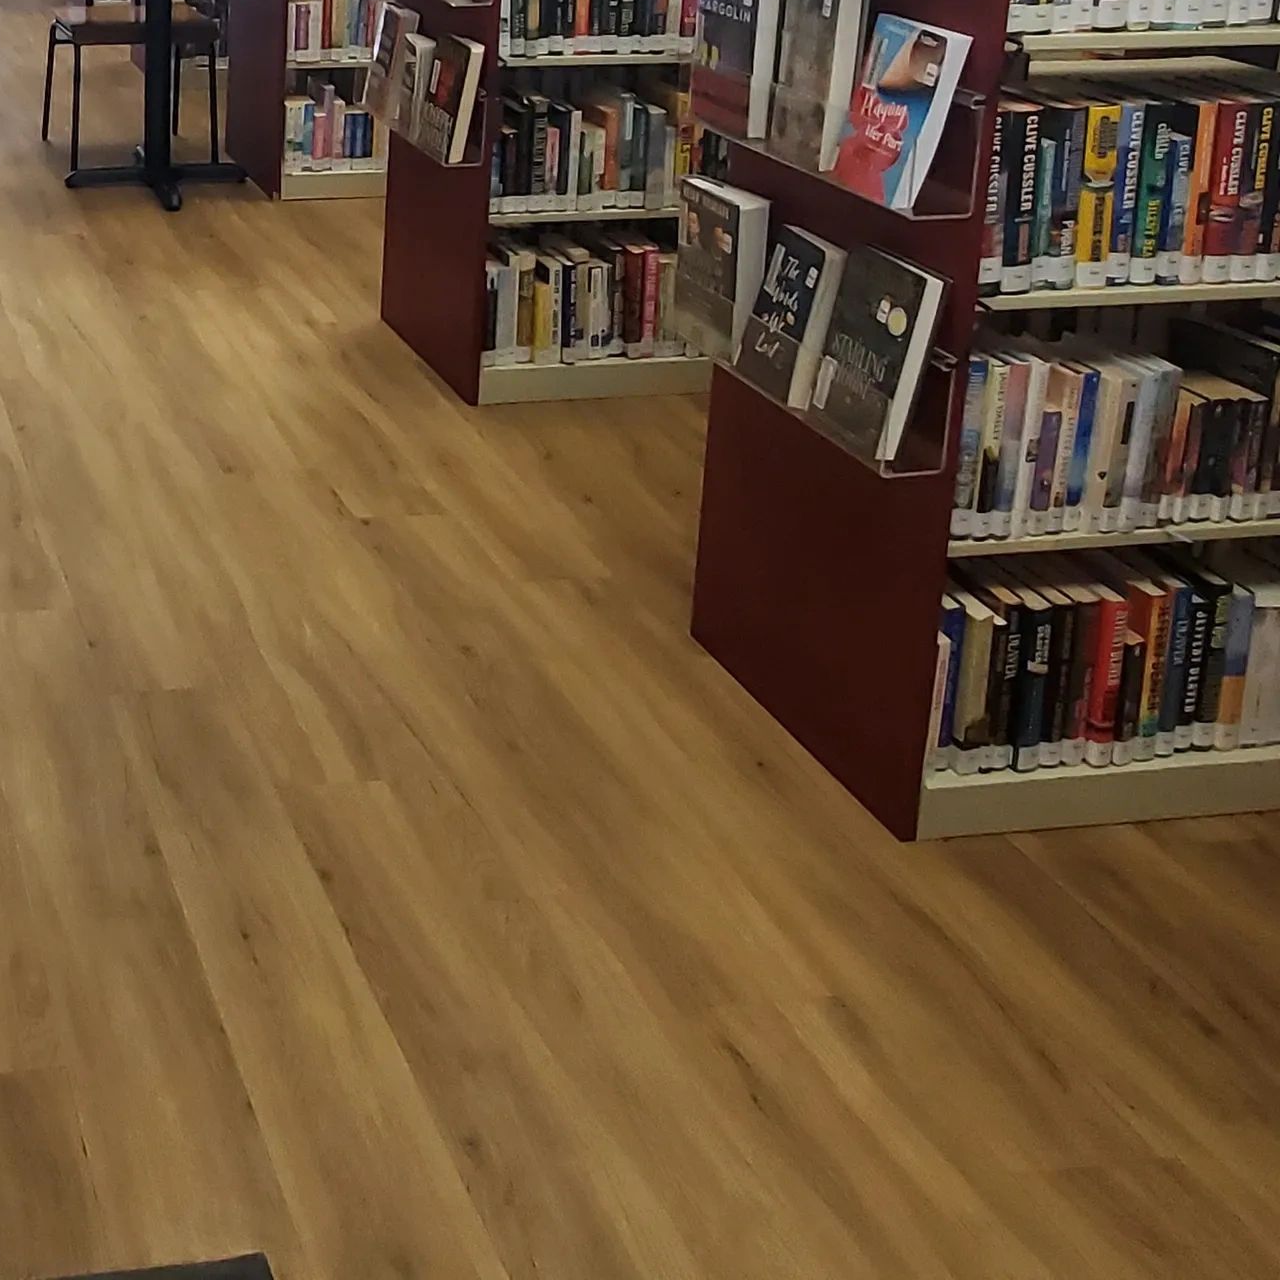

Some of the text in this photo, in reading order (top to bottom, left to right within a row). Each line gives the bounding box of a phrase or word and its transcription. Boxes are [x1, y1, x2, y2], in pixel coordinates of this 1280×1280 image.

[861, 92, 908, 129] Playing
[865, 122, 905, 152] Her Part
[1255, 107, 1273, 190] CLIVE CUSSLER
[1021, 115, 1039, 212] CLIVE CUSSLER
[1123, 111, 1144, 210] CLIVE CUSSLER
[1178, 143, 1190, 173] CLIVE
[1227, 111, 1247, 196] CLIVE CUSSLER
[784, 256, 801, 281] The
[1184, 611, 1208, 713] JEFFERY DEAVER
